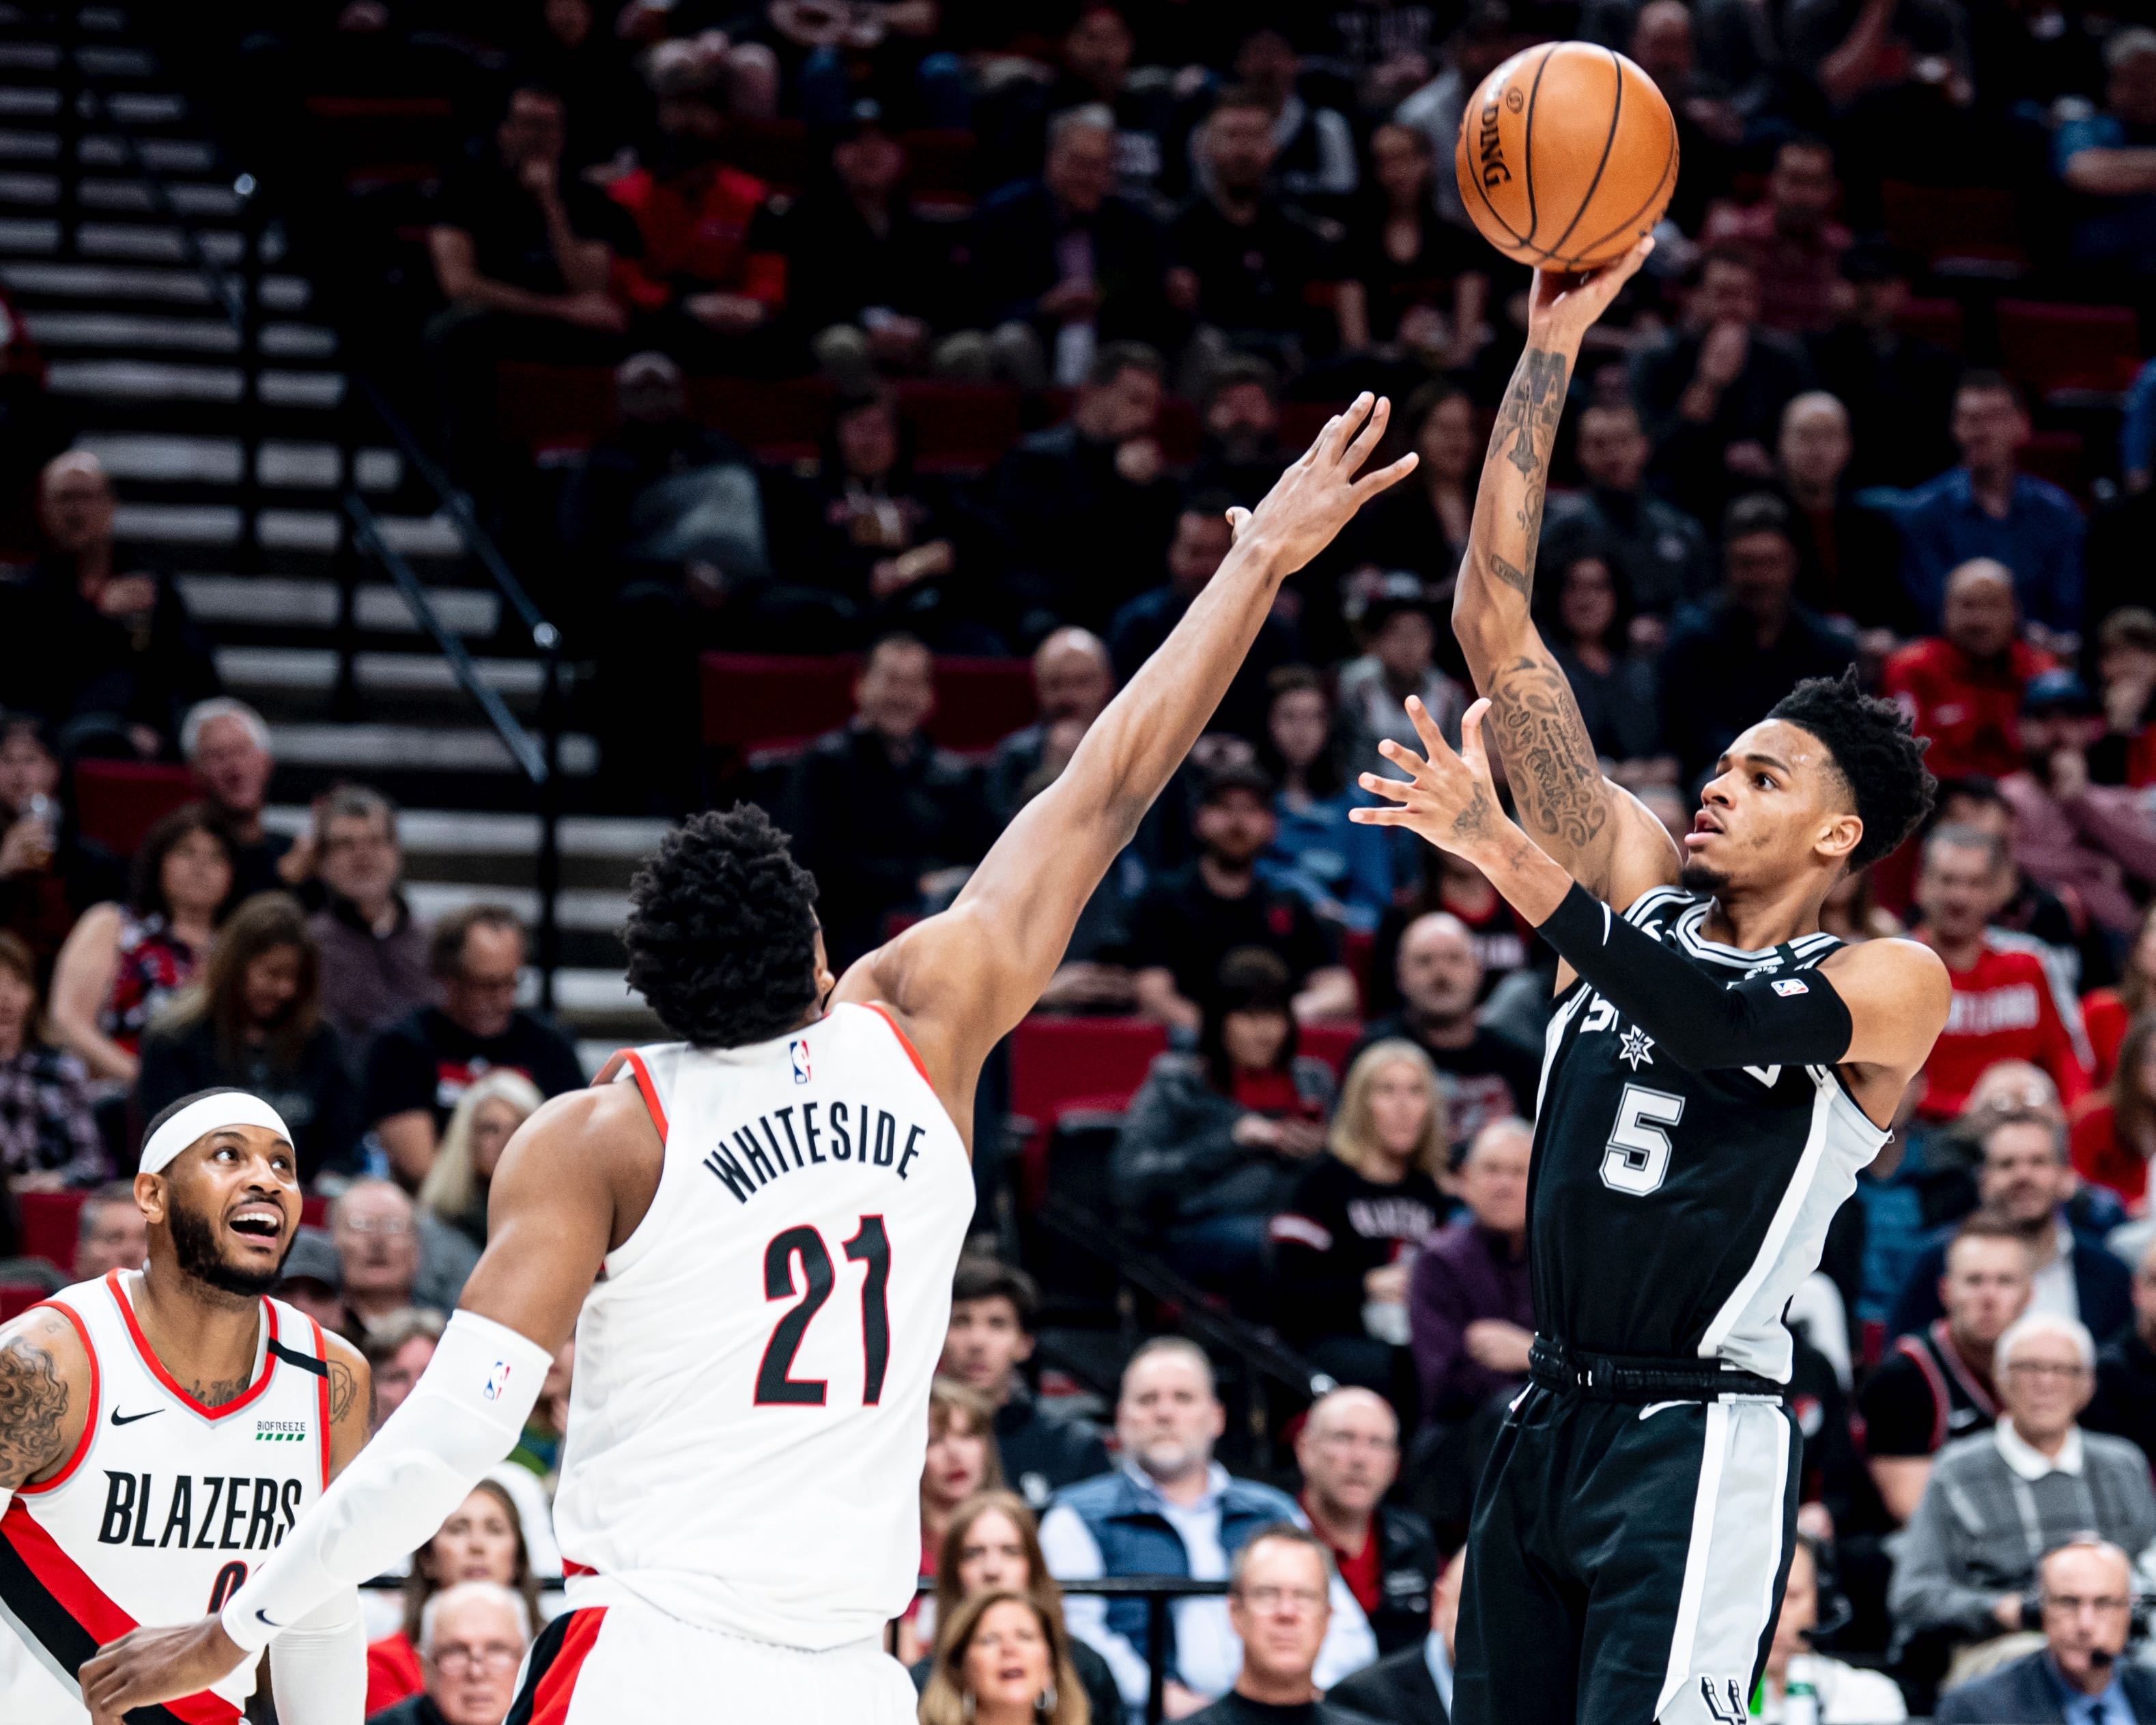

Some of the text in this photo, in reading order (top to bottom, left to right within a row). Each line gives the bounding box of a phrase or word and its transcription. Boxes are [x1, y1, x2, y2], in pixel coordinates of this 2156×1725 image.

[1479, 103, 1512, 189] DING
[703, 1101, 926, 1205] WHITESIDE
[1599, 1082, 1686, 1196] 5
[752, 1214, 892, 1407] 21
[98, 1470, 302, 1550] BLAZERS
